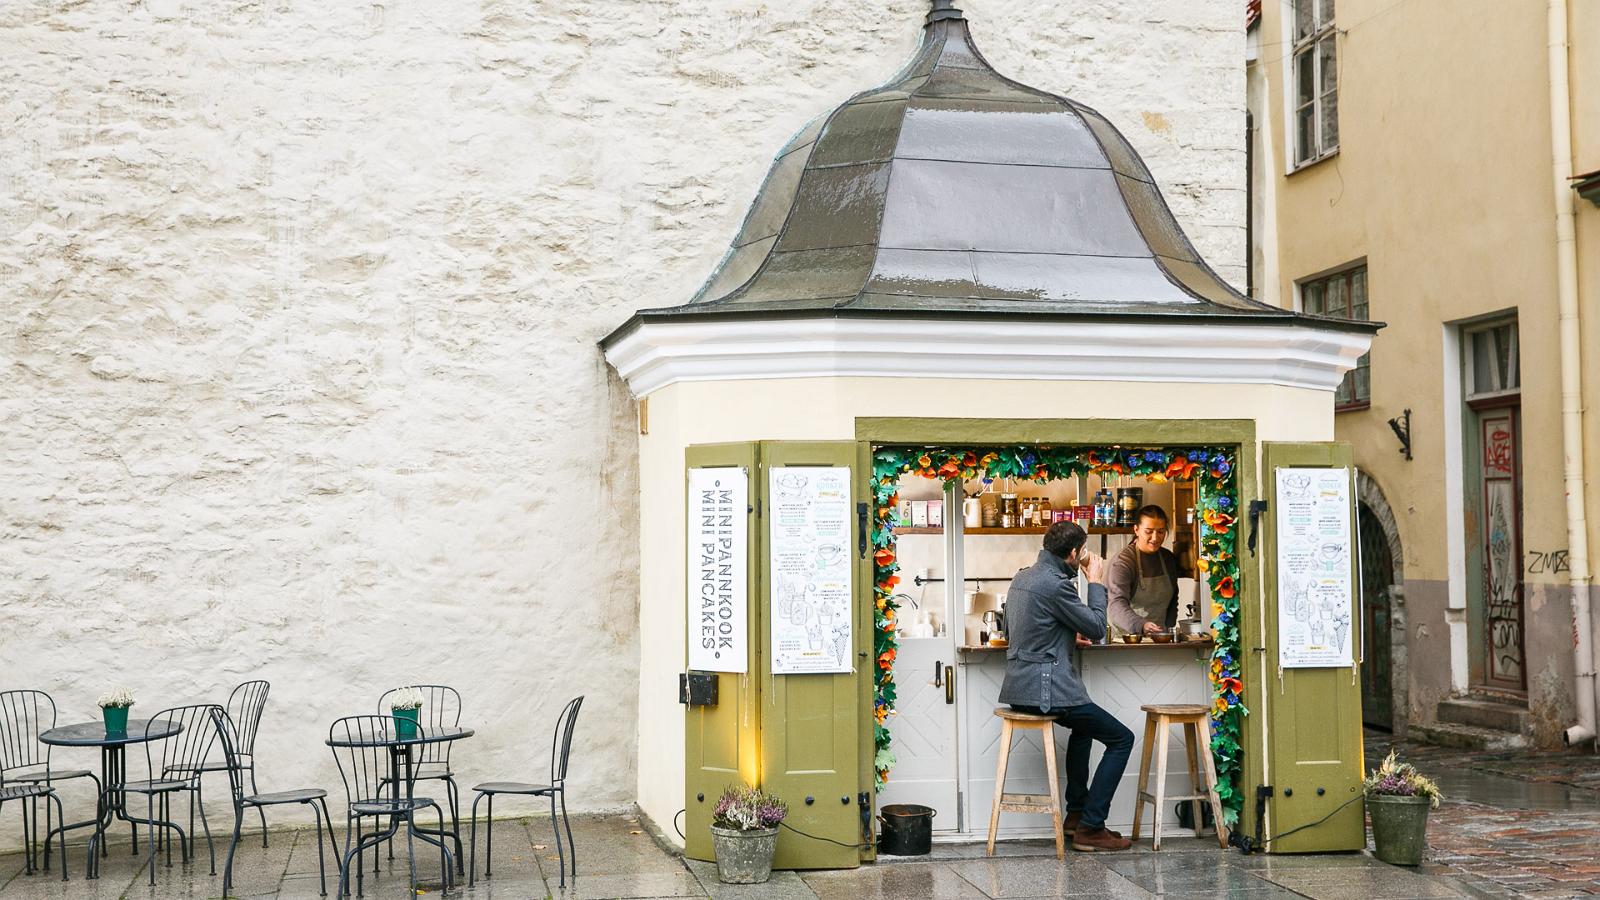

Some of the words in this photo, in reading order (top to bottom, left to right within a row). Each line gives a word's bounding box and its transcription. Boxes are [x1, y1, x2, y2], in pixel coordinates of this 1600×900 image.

[701, 489, 715, 535] MINI
[701, 542, 715, 650] PANCAKES
[718, 489, 732, 649] MINIPANNKOOK
